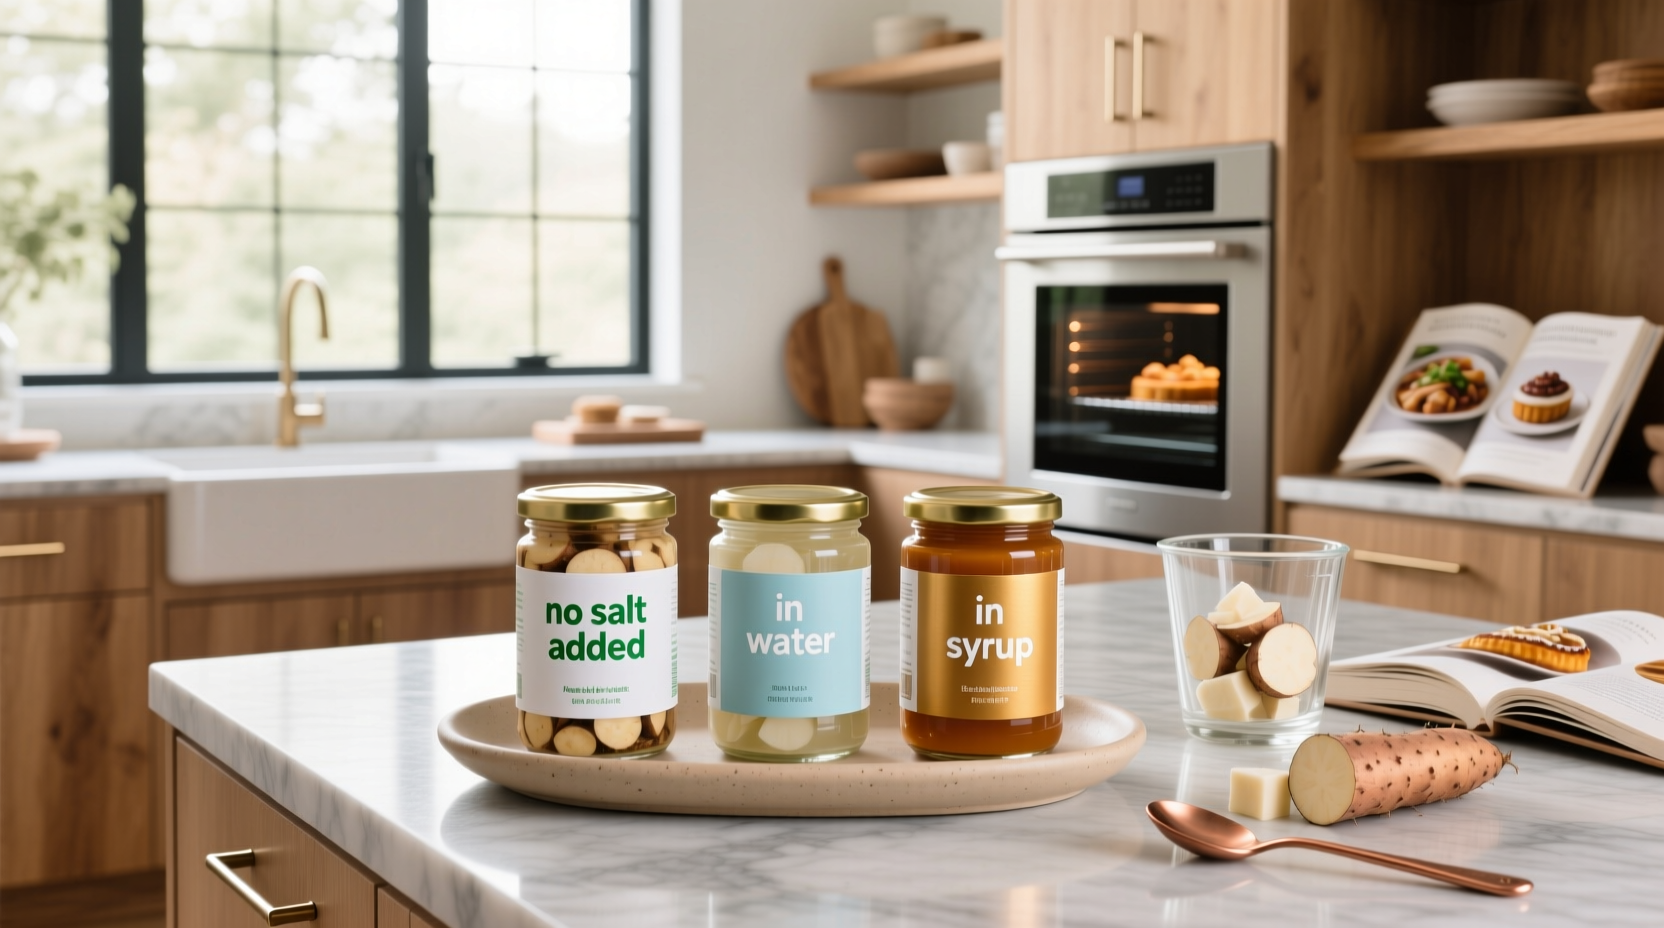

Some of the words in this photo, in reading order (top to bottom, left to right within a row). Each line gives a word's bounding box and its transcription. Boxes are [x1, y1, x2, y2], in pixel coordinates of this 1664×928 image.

[546, 602, 583, 625] no
[591, 594, 647, 625] salt
[776, 593, 803, 622] in
[976, 595, 1004, 625] in
[548, 629, 645, 661] added
[746, 628, 836, 655] water
[946, 636, 1034, 667] syrup
